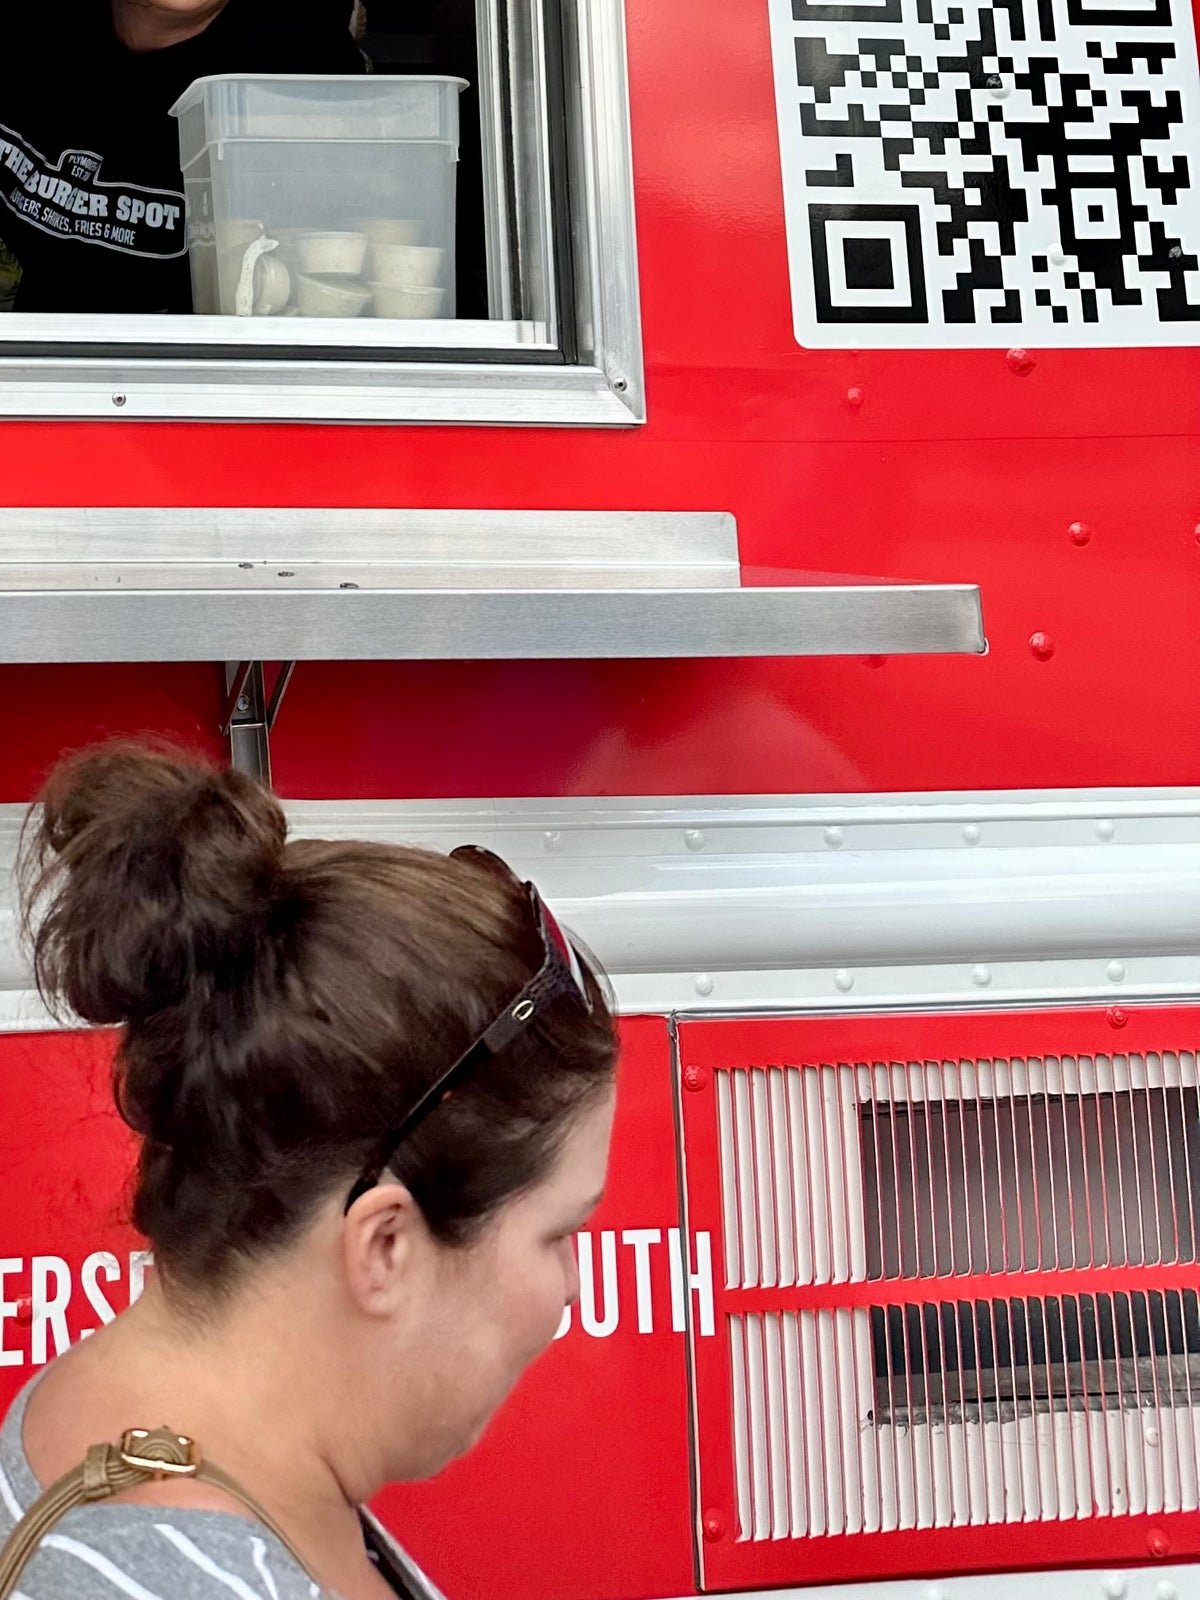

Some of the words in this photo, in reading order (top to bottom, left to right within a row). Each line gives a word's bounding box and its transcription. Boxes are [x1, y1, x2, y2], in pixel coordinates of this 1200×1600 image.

[23, 169, 109, 217] BURGER
[115, 194, 181, 231] SPOT
[74, 219, 103, 237] FRIES
[103, 223, 111, 239] &
[110, 225, 136, 246] MORE
